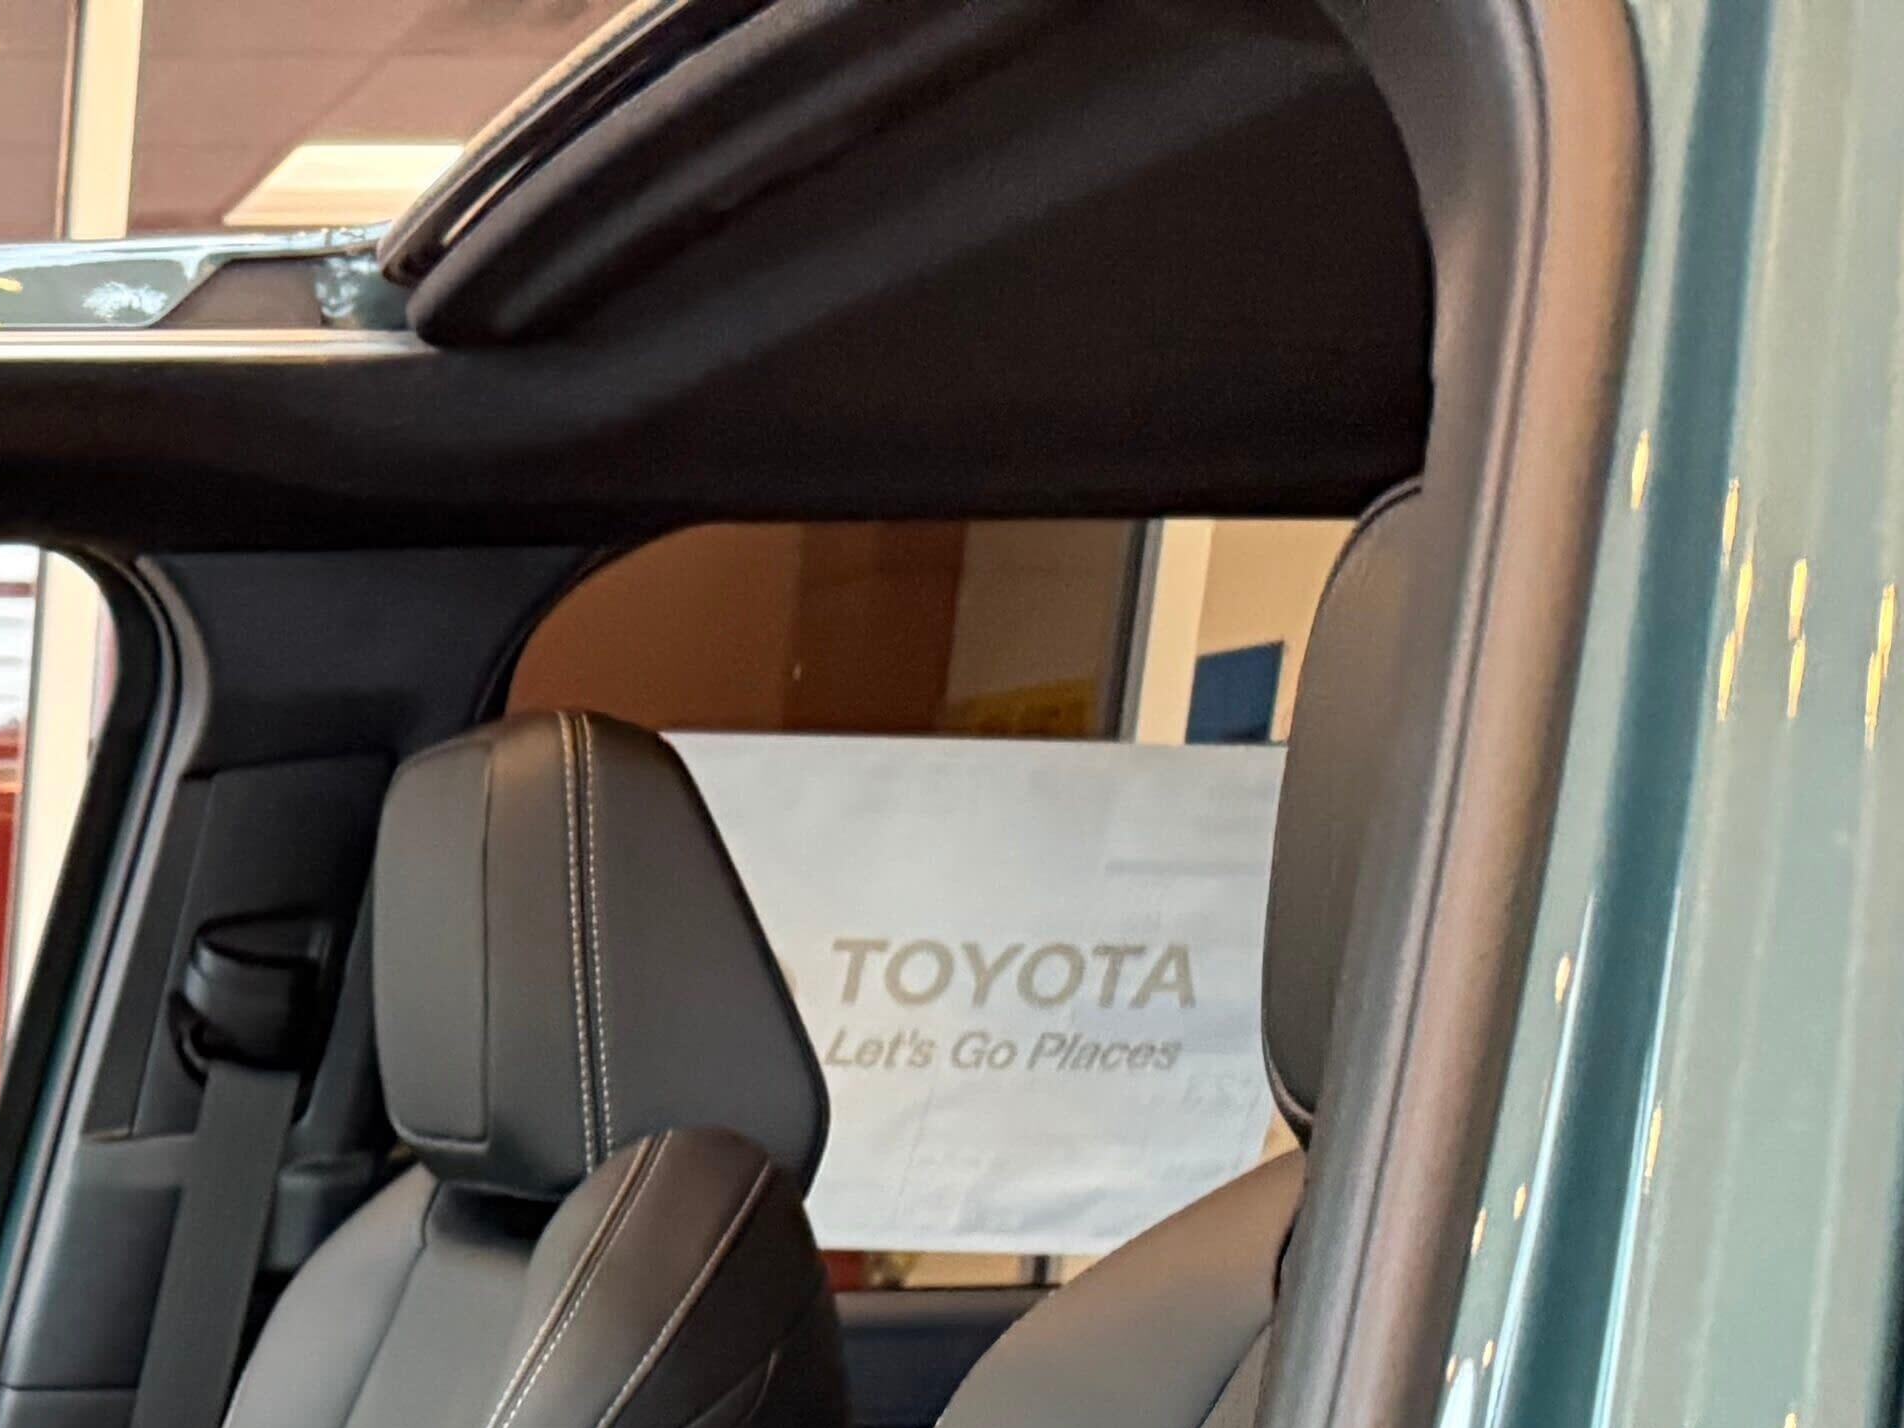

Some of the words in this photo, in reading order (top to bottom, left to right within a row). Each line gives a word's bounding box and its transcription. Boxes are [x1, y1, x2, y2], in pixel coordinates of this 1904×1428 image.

[830, 937, 1198, 1010] TOYOTA
[825, 1031, 937, 1070] Let's
[950, 1031, 1019, 1070] Go
[1027, 1031, 1182, 1071] Places
